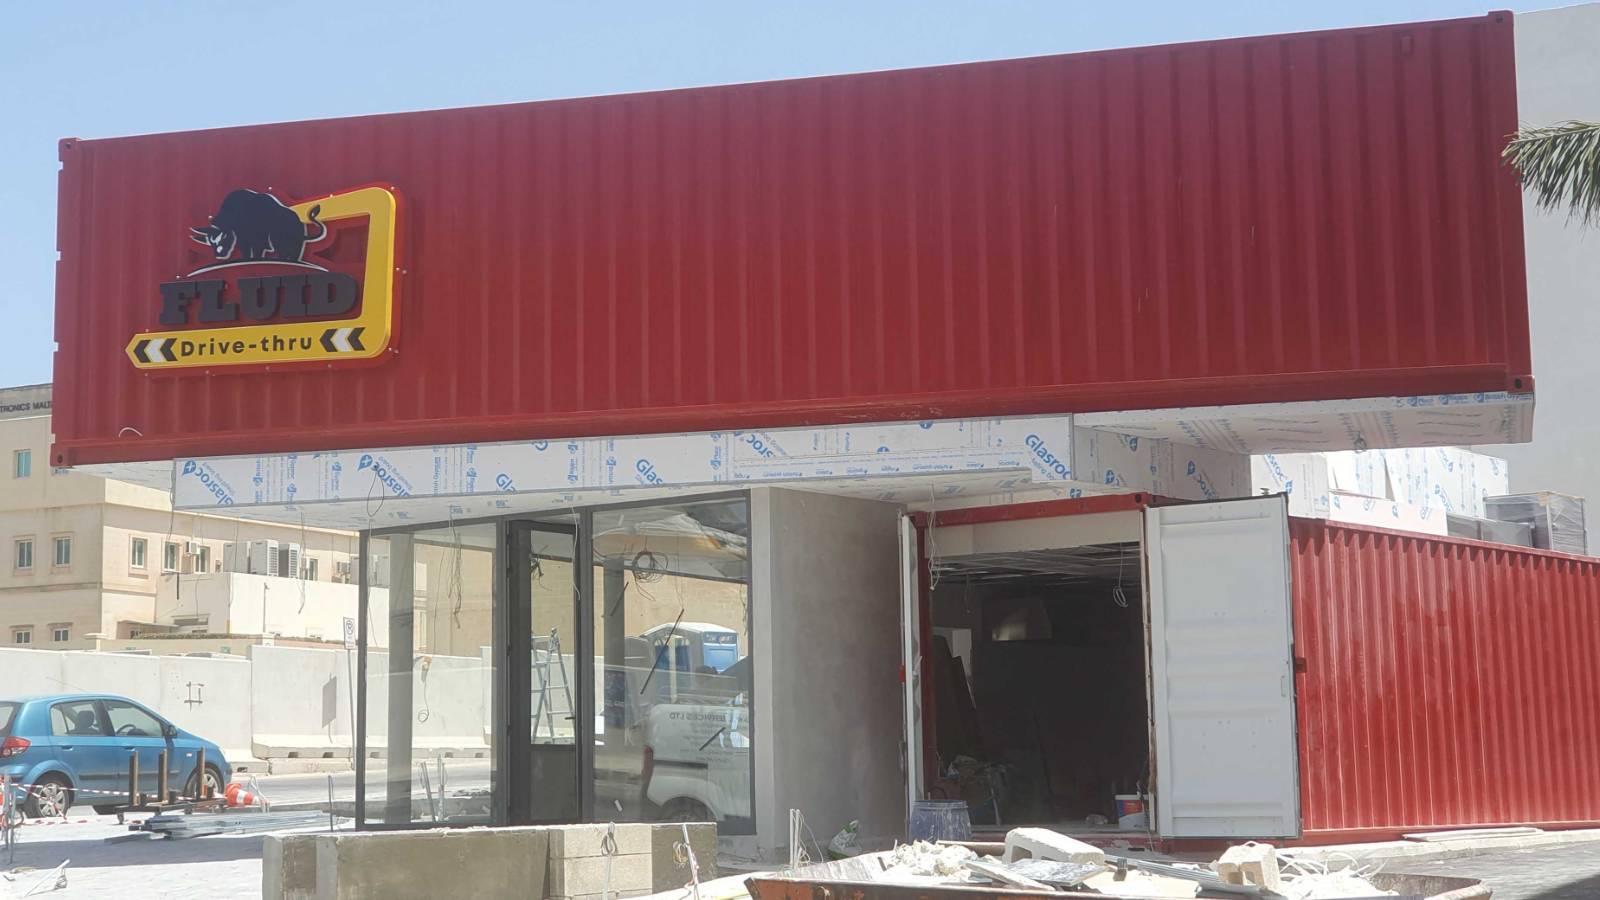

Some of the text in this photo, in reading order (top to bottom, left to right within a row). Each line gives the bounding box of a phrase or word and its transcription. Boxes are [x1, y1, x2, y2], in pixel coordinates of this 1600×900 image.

[160, 274, 357, 324] FLUID
[181, 336, 312, 357] Drive-thru
[1025, 435, 1072, 480] Glasroc
[371, 461, 411, 497] lasroc
